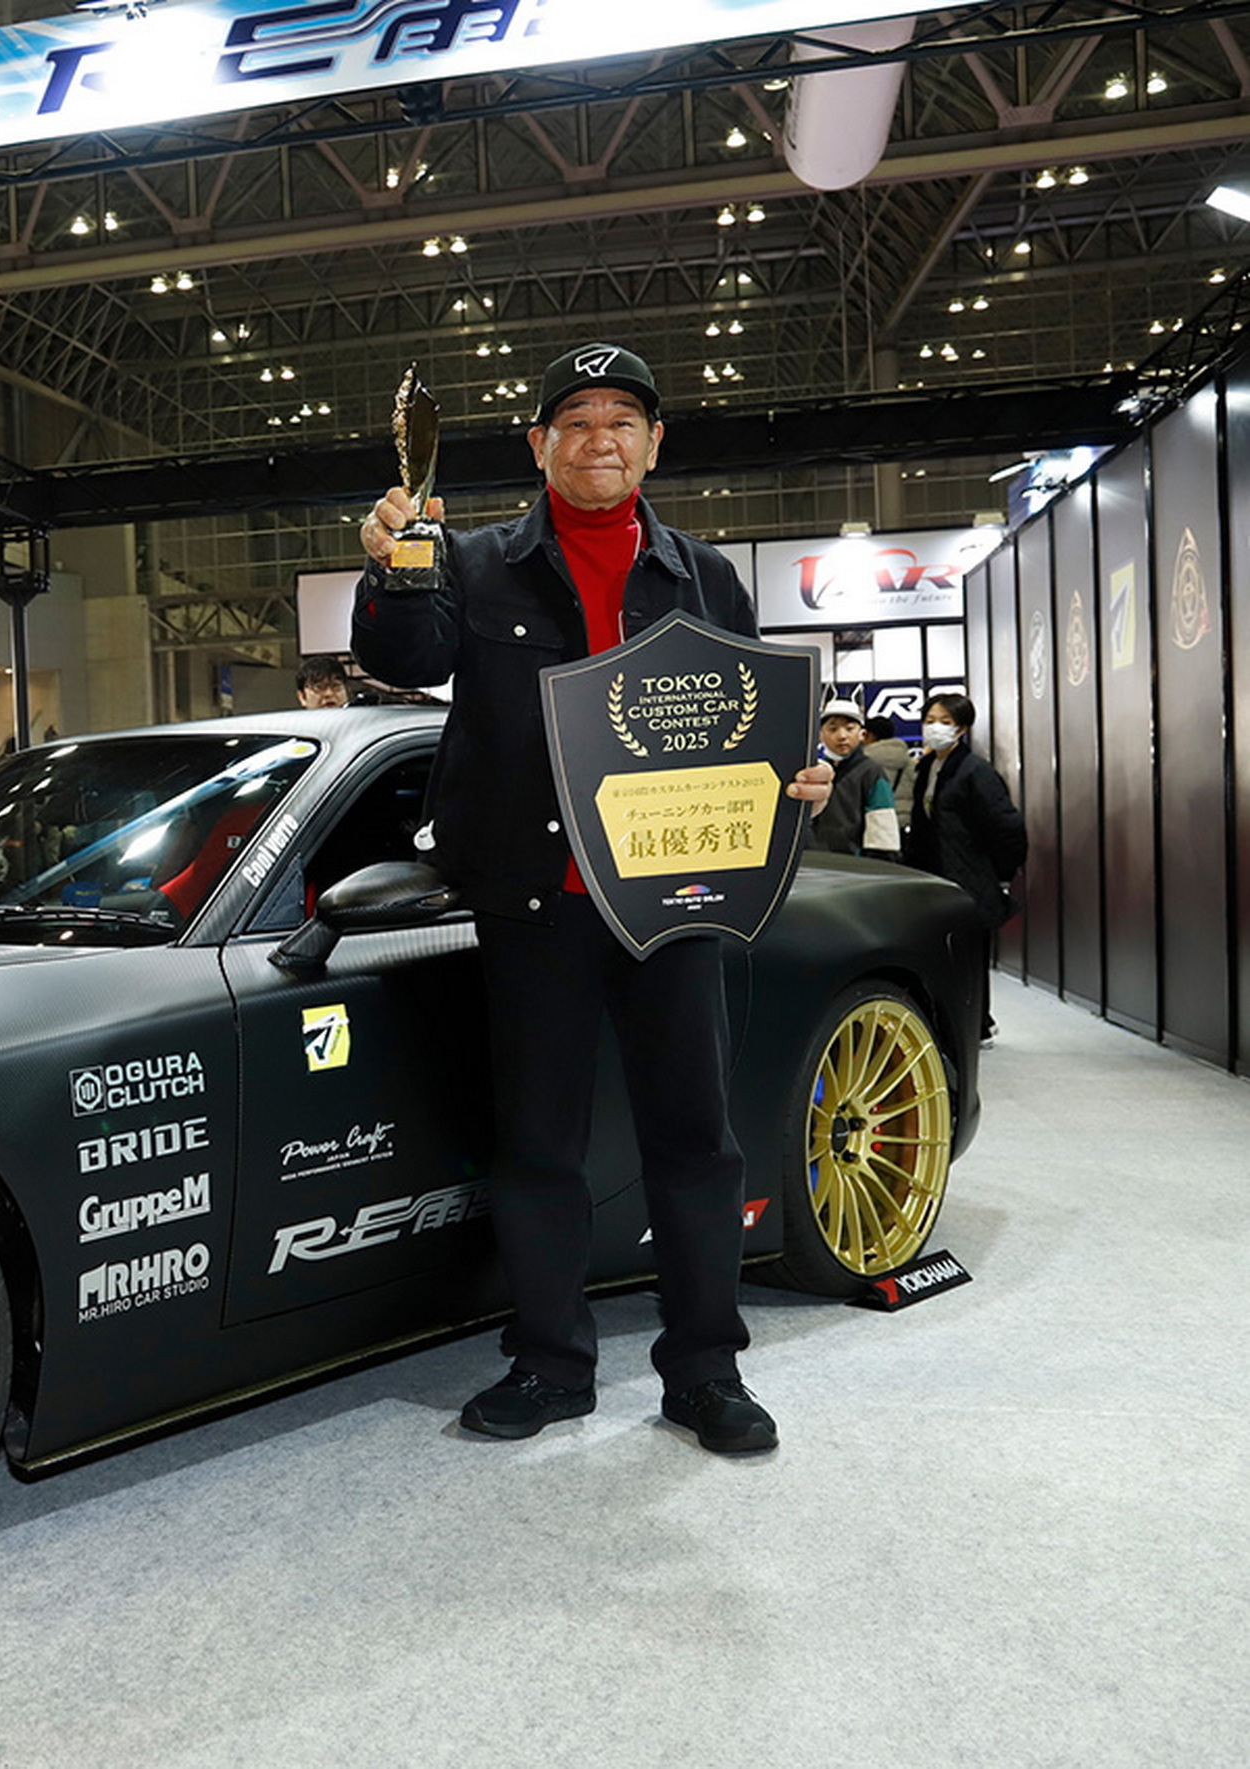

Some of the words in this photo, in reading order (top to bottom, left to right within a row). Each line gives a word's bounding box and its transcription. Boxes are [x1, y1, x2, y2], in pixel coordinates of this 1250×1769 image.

[638, 690, 727, 704] INTERNATIONAL
[641, 672, 723, 694] TOKYO
[628, 703, 699, 719] CUSTOM
[703, 699, 740, 713] CAR
[648, 715, 721, 730] CONTEST
[661, 732, 710, 751] 2025
[626, 799, 754, 821] チューニングカー部門
[628, 820, 754, 858] 最優秀賞
[105, 1051, 203, 1086] OGURA
[107, 1072, 205, 1109] CLUTCH
[77, 1116, 210, 1173] BRIDE
[280, 1140, 340, 1165] Power
[346, 1122, 395, 1154] Craft
[79, 1173, 210, 1236] GruppeM
[134, 1289, 161, 1307] CAR
[163, 1276, 210, 1299] STUDIO
[895, 1258, 965, 1294] YOKOHAMA
